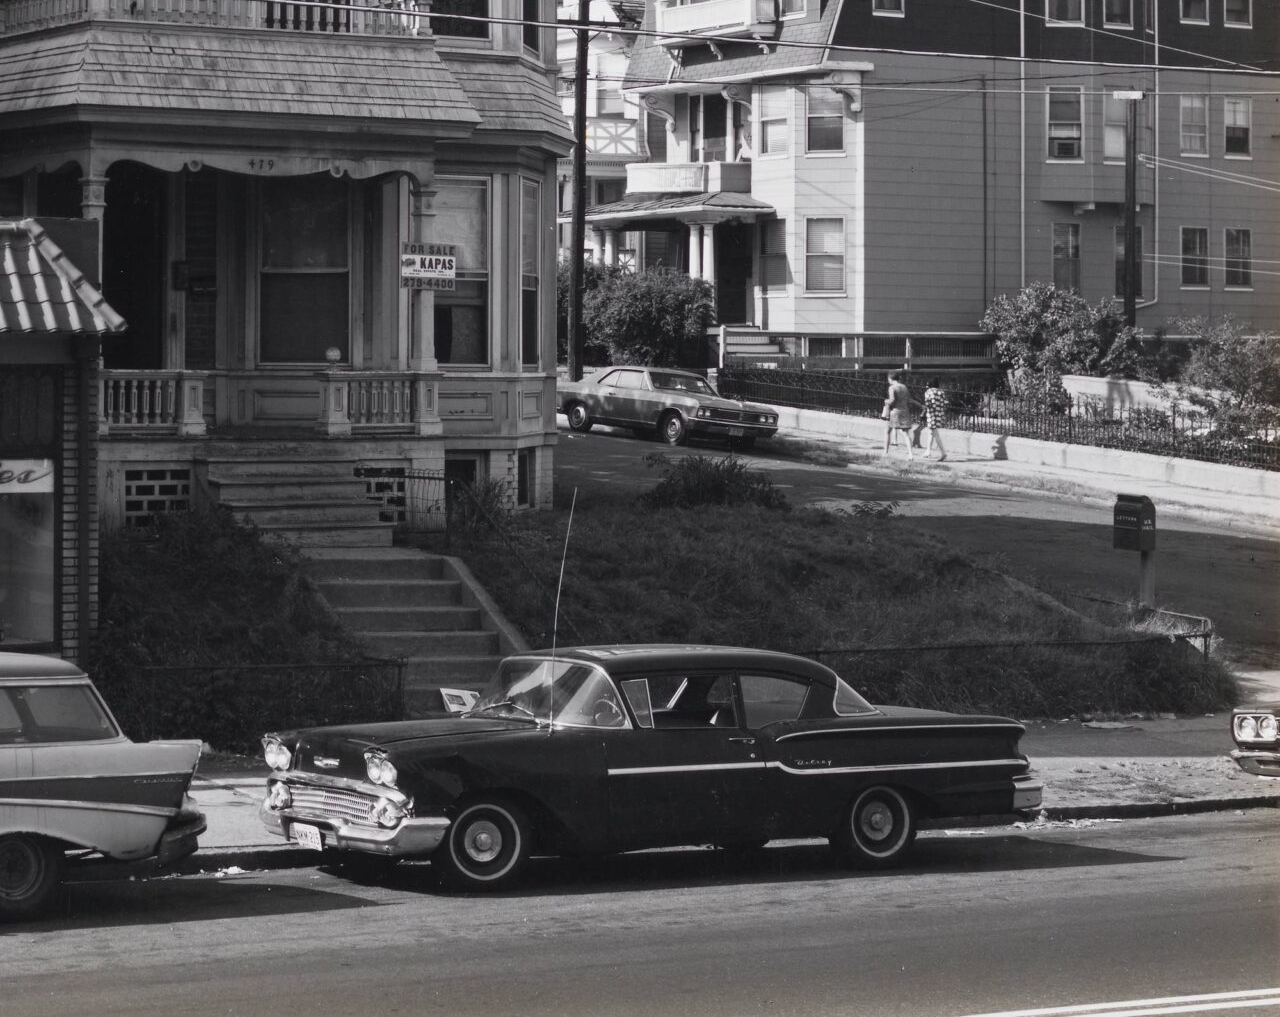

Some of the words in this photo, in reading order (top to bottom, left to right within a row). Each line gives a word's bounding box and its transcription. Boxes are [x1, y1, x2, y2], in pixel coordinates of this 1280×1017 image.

[404, 244, 424, 255] FOR
[429, 245, 455, 256] SALE
[420, 257, 454, 270] KAPAS
